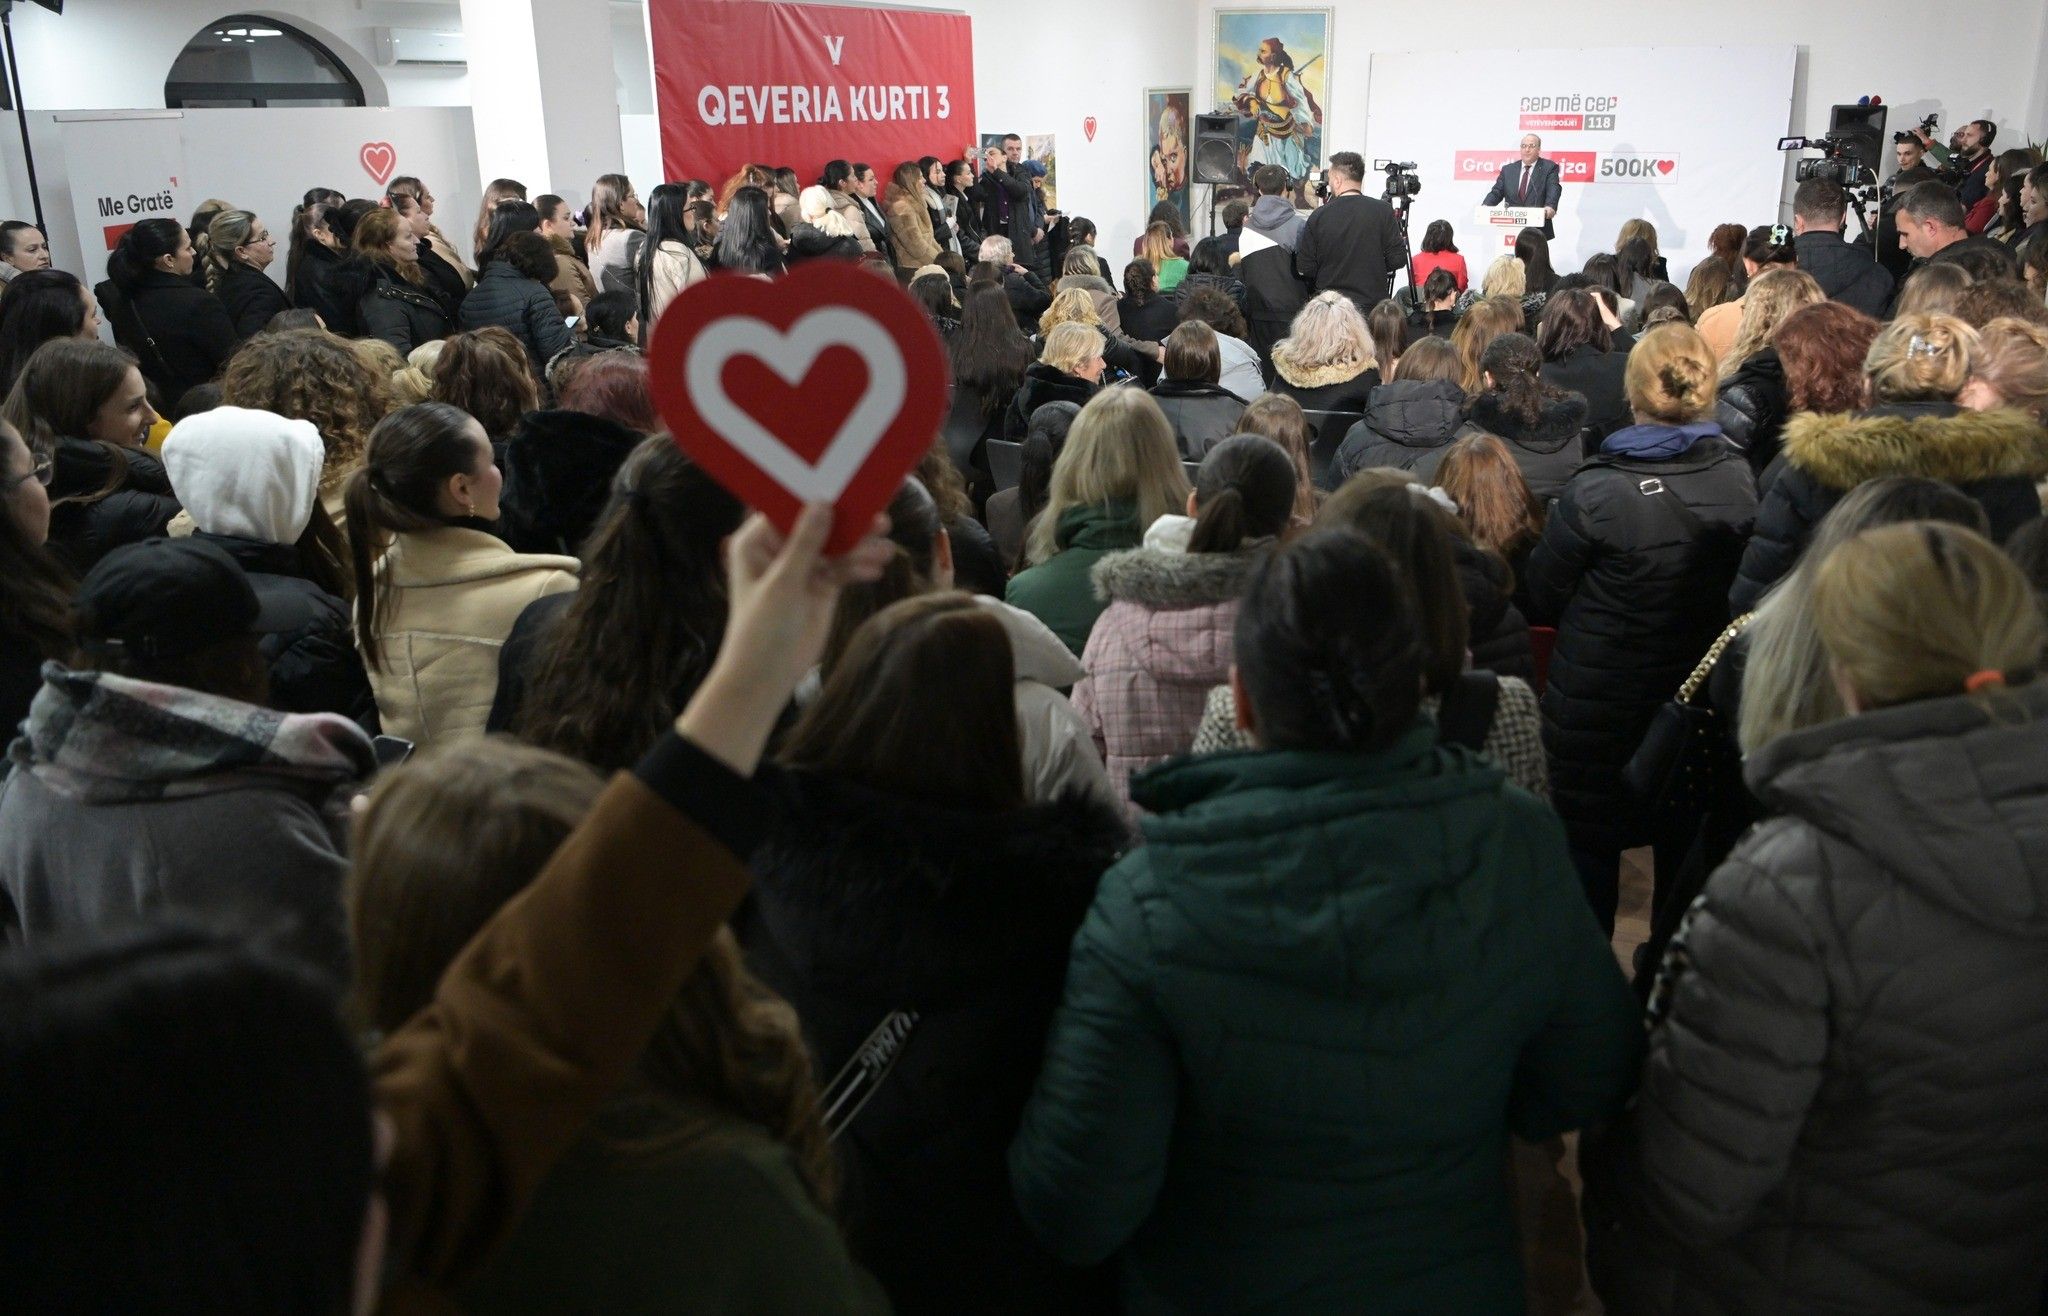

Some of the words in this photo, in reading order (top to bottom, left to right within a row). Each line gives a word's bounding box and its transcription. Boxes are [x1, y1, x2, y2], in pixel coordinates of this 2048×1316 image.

[823, 35, 844, 66] V
[697, 85, 844, 126] QEVERIA
[849, 85, 930, 122] KURTI
[936, 85, 950, 119] 3
[1588, 117, 1611, 129] 118
[1462, 158, 1494, 172] Gra
[1600, 158, 1657, 178] 500K
[98, 197, 124, 217] Me
[127, 190, 173, 213] Gratë
